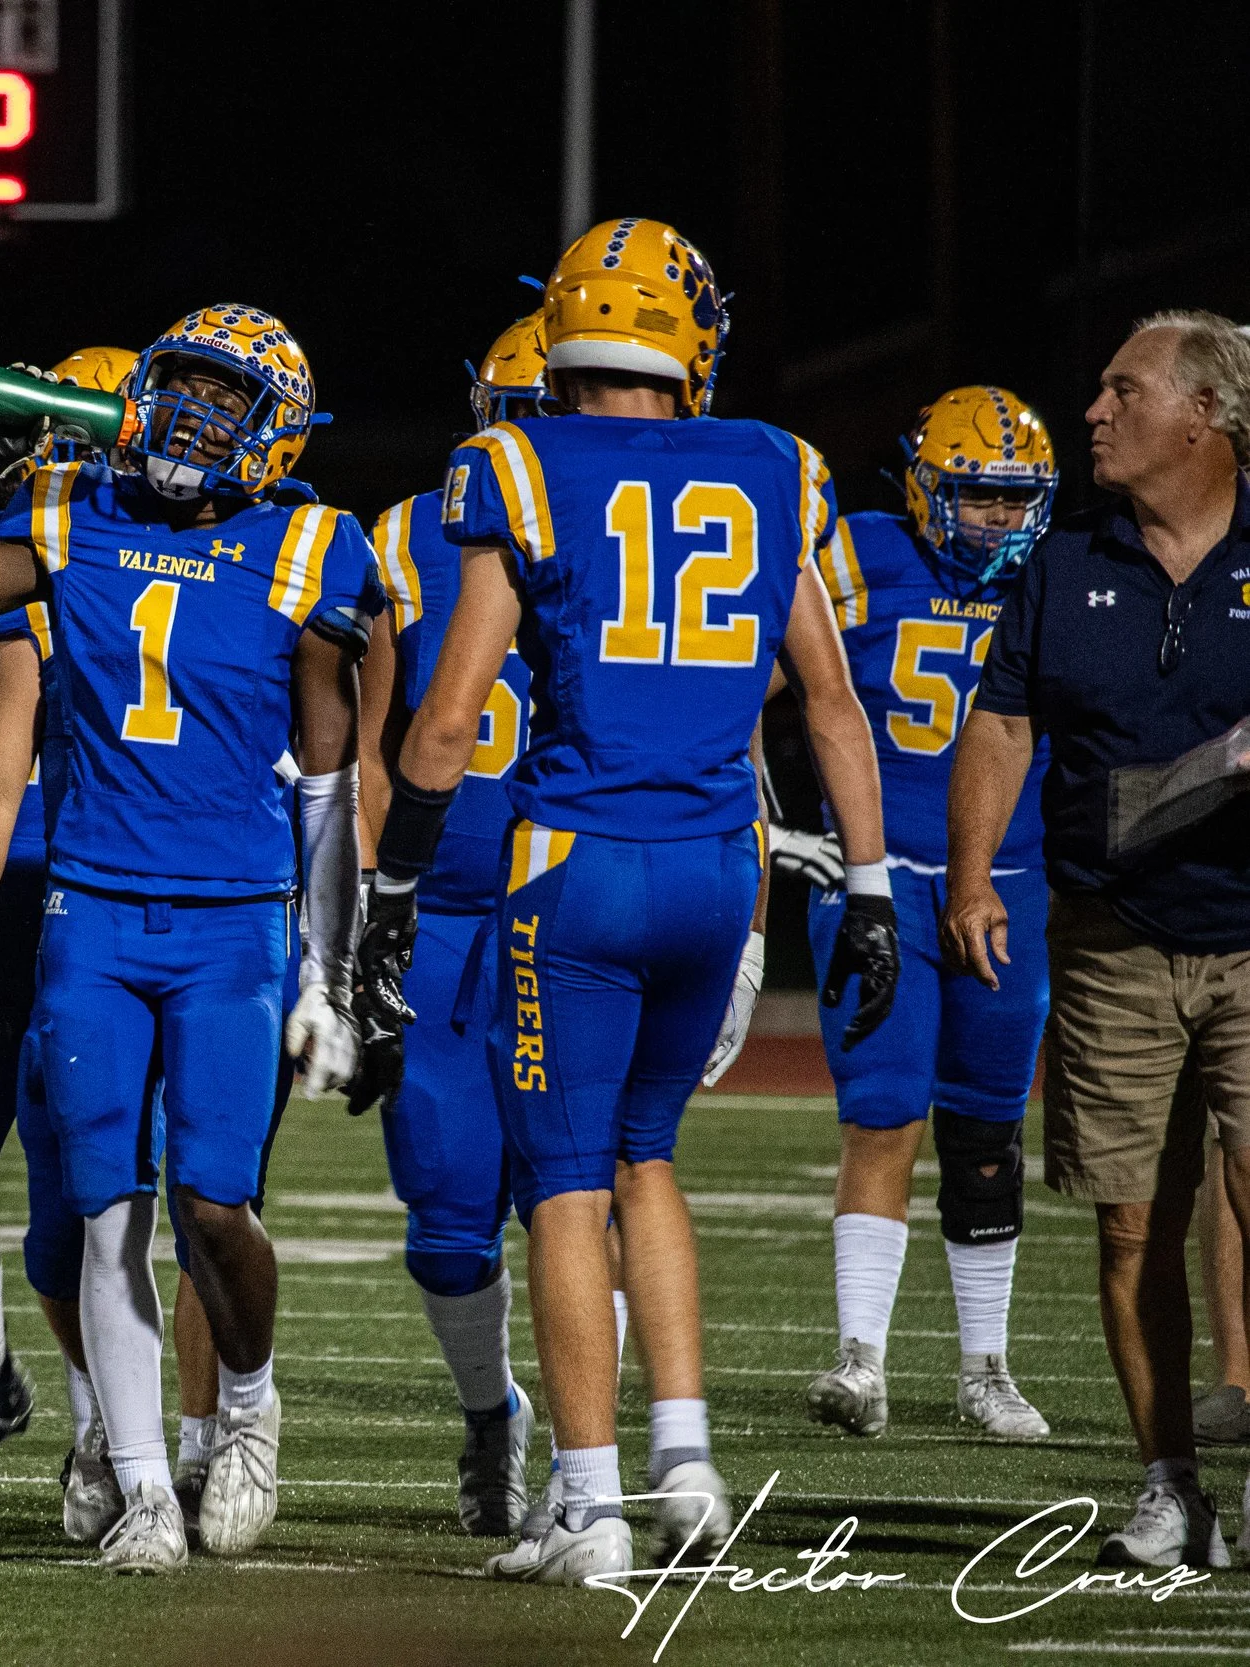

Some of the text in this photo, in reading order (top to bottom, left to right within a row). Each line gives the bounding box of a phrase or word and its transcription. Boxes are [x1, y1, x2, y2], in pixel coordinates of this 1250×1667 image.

[193, 335, 239, 353] Riddell
[119, 549, 215, 582] VALENCIA
[599, 480, 759, 668] 12
[930, 598, 1002, 621] VALENC
[120, 579, 183, 746] 1
[886, 618, 994, 757] 5
[510, 914, 547, 1092] TIGERS
